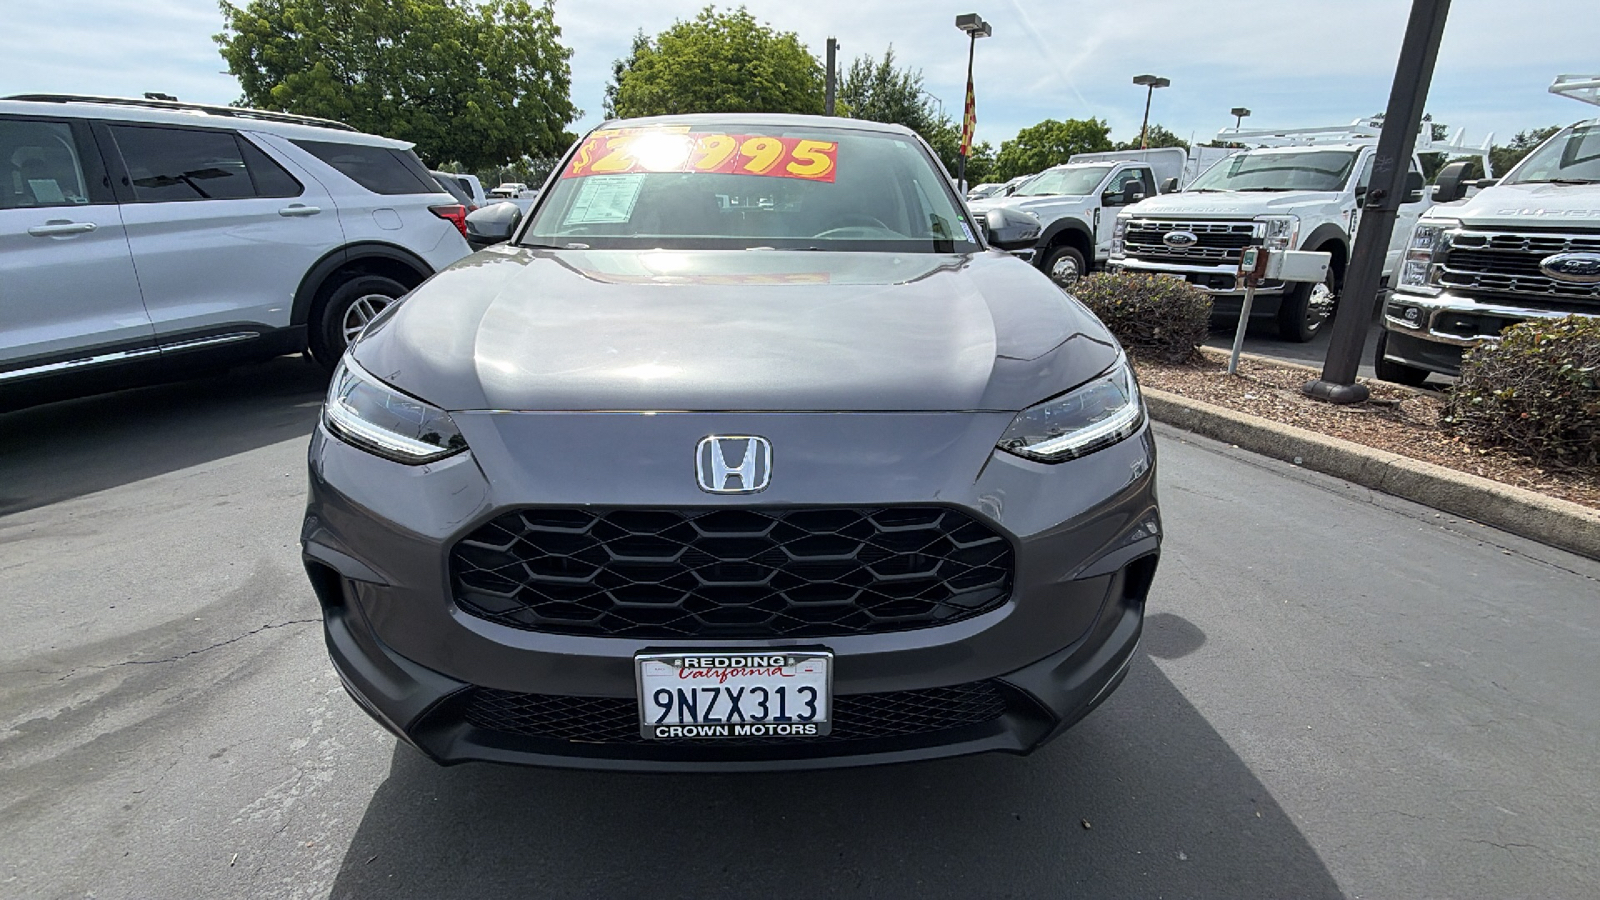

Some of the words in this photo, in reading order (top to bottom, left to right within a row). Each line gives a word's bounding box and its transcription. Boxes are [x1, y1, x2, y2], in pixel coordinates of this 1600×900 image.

[572, 133, 834, 176] $2995
[684, 656, 785, 668] REDDING
[678, 665, 796, 684] California
[653, 686, 818, 724] 9NZX313
[655, 725, 729, 738] CROWN
[734, 724, 817, 737] MOTORS
